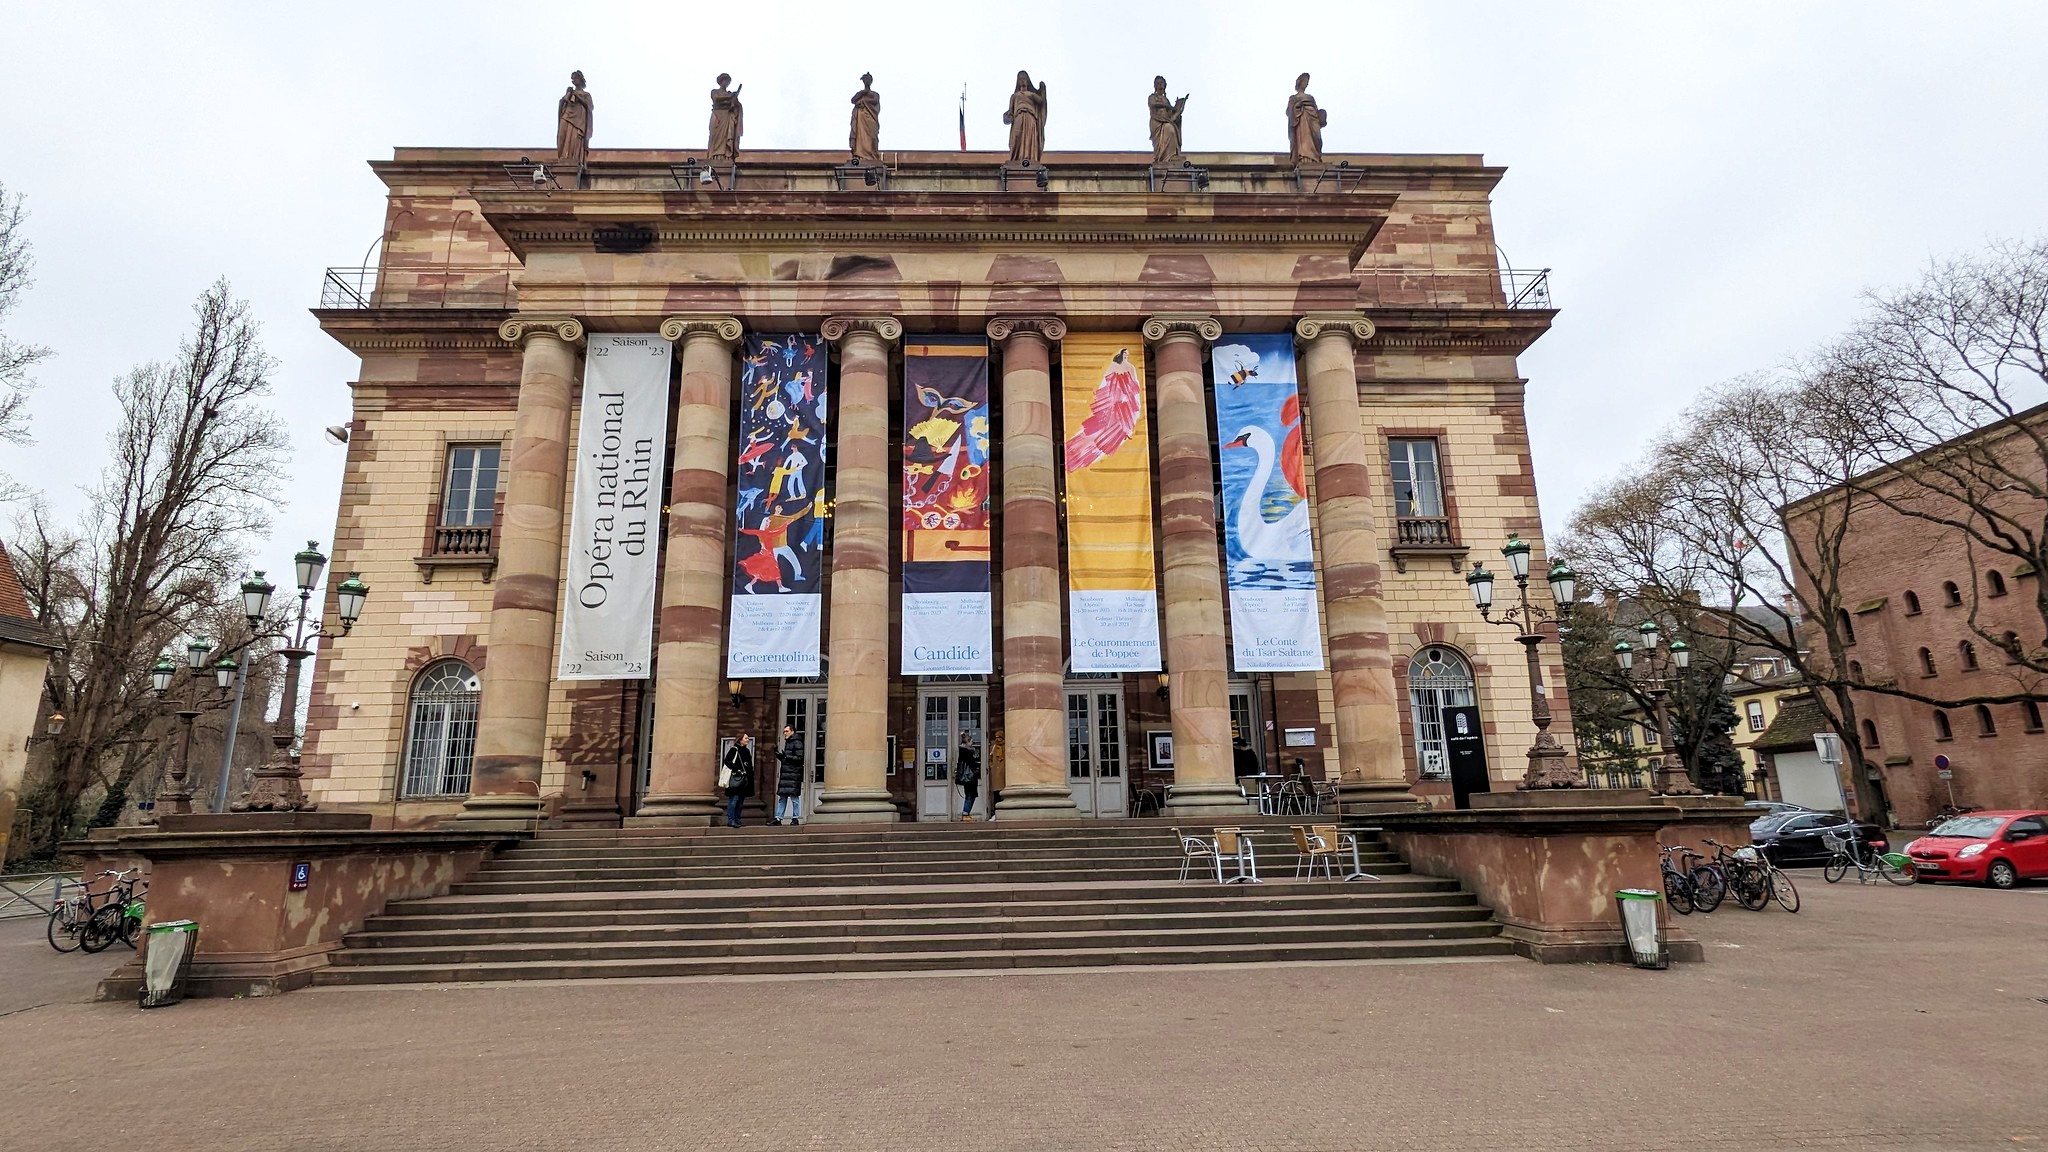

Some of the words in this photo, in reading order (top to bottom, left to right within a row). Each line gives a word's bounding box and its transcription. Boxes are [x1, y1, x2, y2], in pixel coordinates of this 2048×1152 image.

[612, 337, 648, 347] Saison
[592, 391, 625, 508] national
[622, 437, 653, 512] Rhin
[619, 520, 646, 557] du
[579, 515, 615, 609] Opéra
[1074, 638, 1087, 647] Le
[1087, 637, 1156, 647] Couronnement
[1256, 637, 1269, 646] Le
[1270, 637, 1298, 646] Conte
[585, 650, 624, 662] Saison
[733, 651, 816, 663] Cenerentolina
[914, 645, 980, 660] Candide
[1092, 649, 1103, 658] de
[1105, 648, 1140, 659] Poppée
[1242, 648, 1254, 657] du
[1256, 648, 1277, 657] Tsar
[1279, 647, 1314, 657] Saltane
